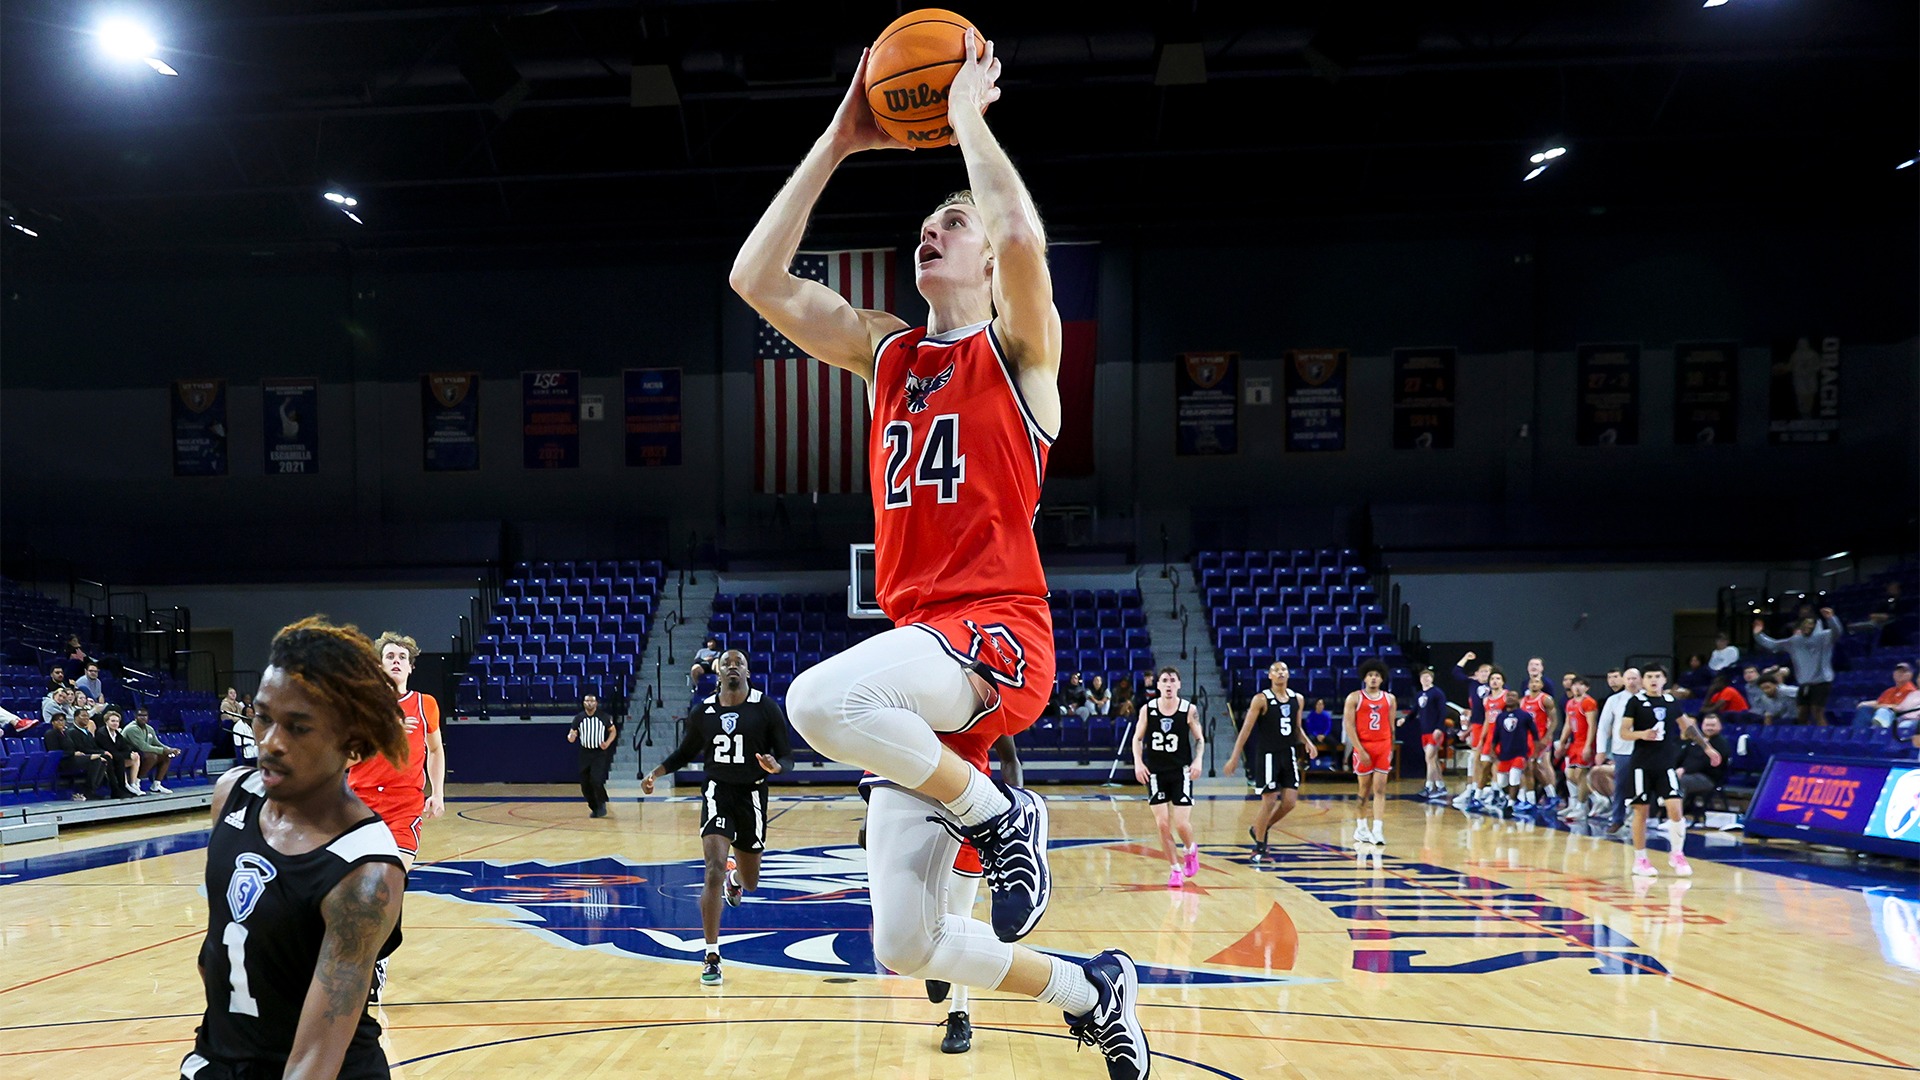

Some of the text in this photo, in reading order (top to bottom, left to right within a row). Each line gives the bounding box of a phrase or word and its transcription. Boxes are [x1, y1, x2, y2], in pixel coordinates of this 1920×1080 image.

[907, 125, 954, 141] NCA
[533, 373, 560, 389] LSC
[588, 406, 595, 418] 6
[279, 461, 305, 473] 2021
[883, 413, 965, 510] 24
[1280, 717, 1292, 736] 5
[1369, 712, 1381, 730] 2
[713, 734, 745, 764] 21
[1152, 731, 1179, 752] 23
[1780, 775, 1861, 808] PATRIOTS
[715, 817, 726, 829] 21
[222, 921, 260, 1018] 1
